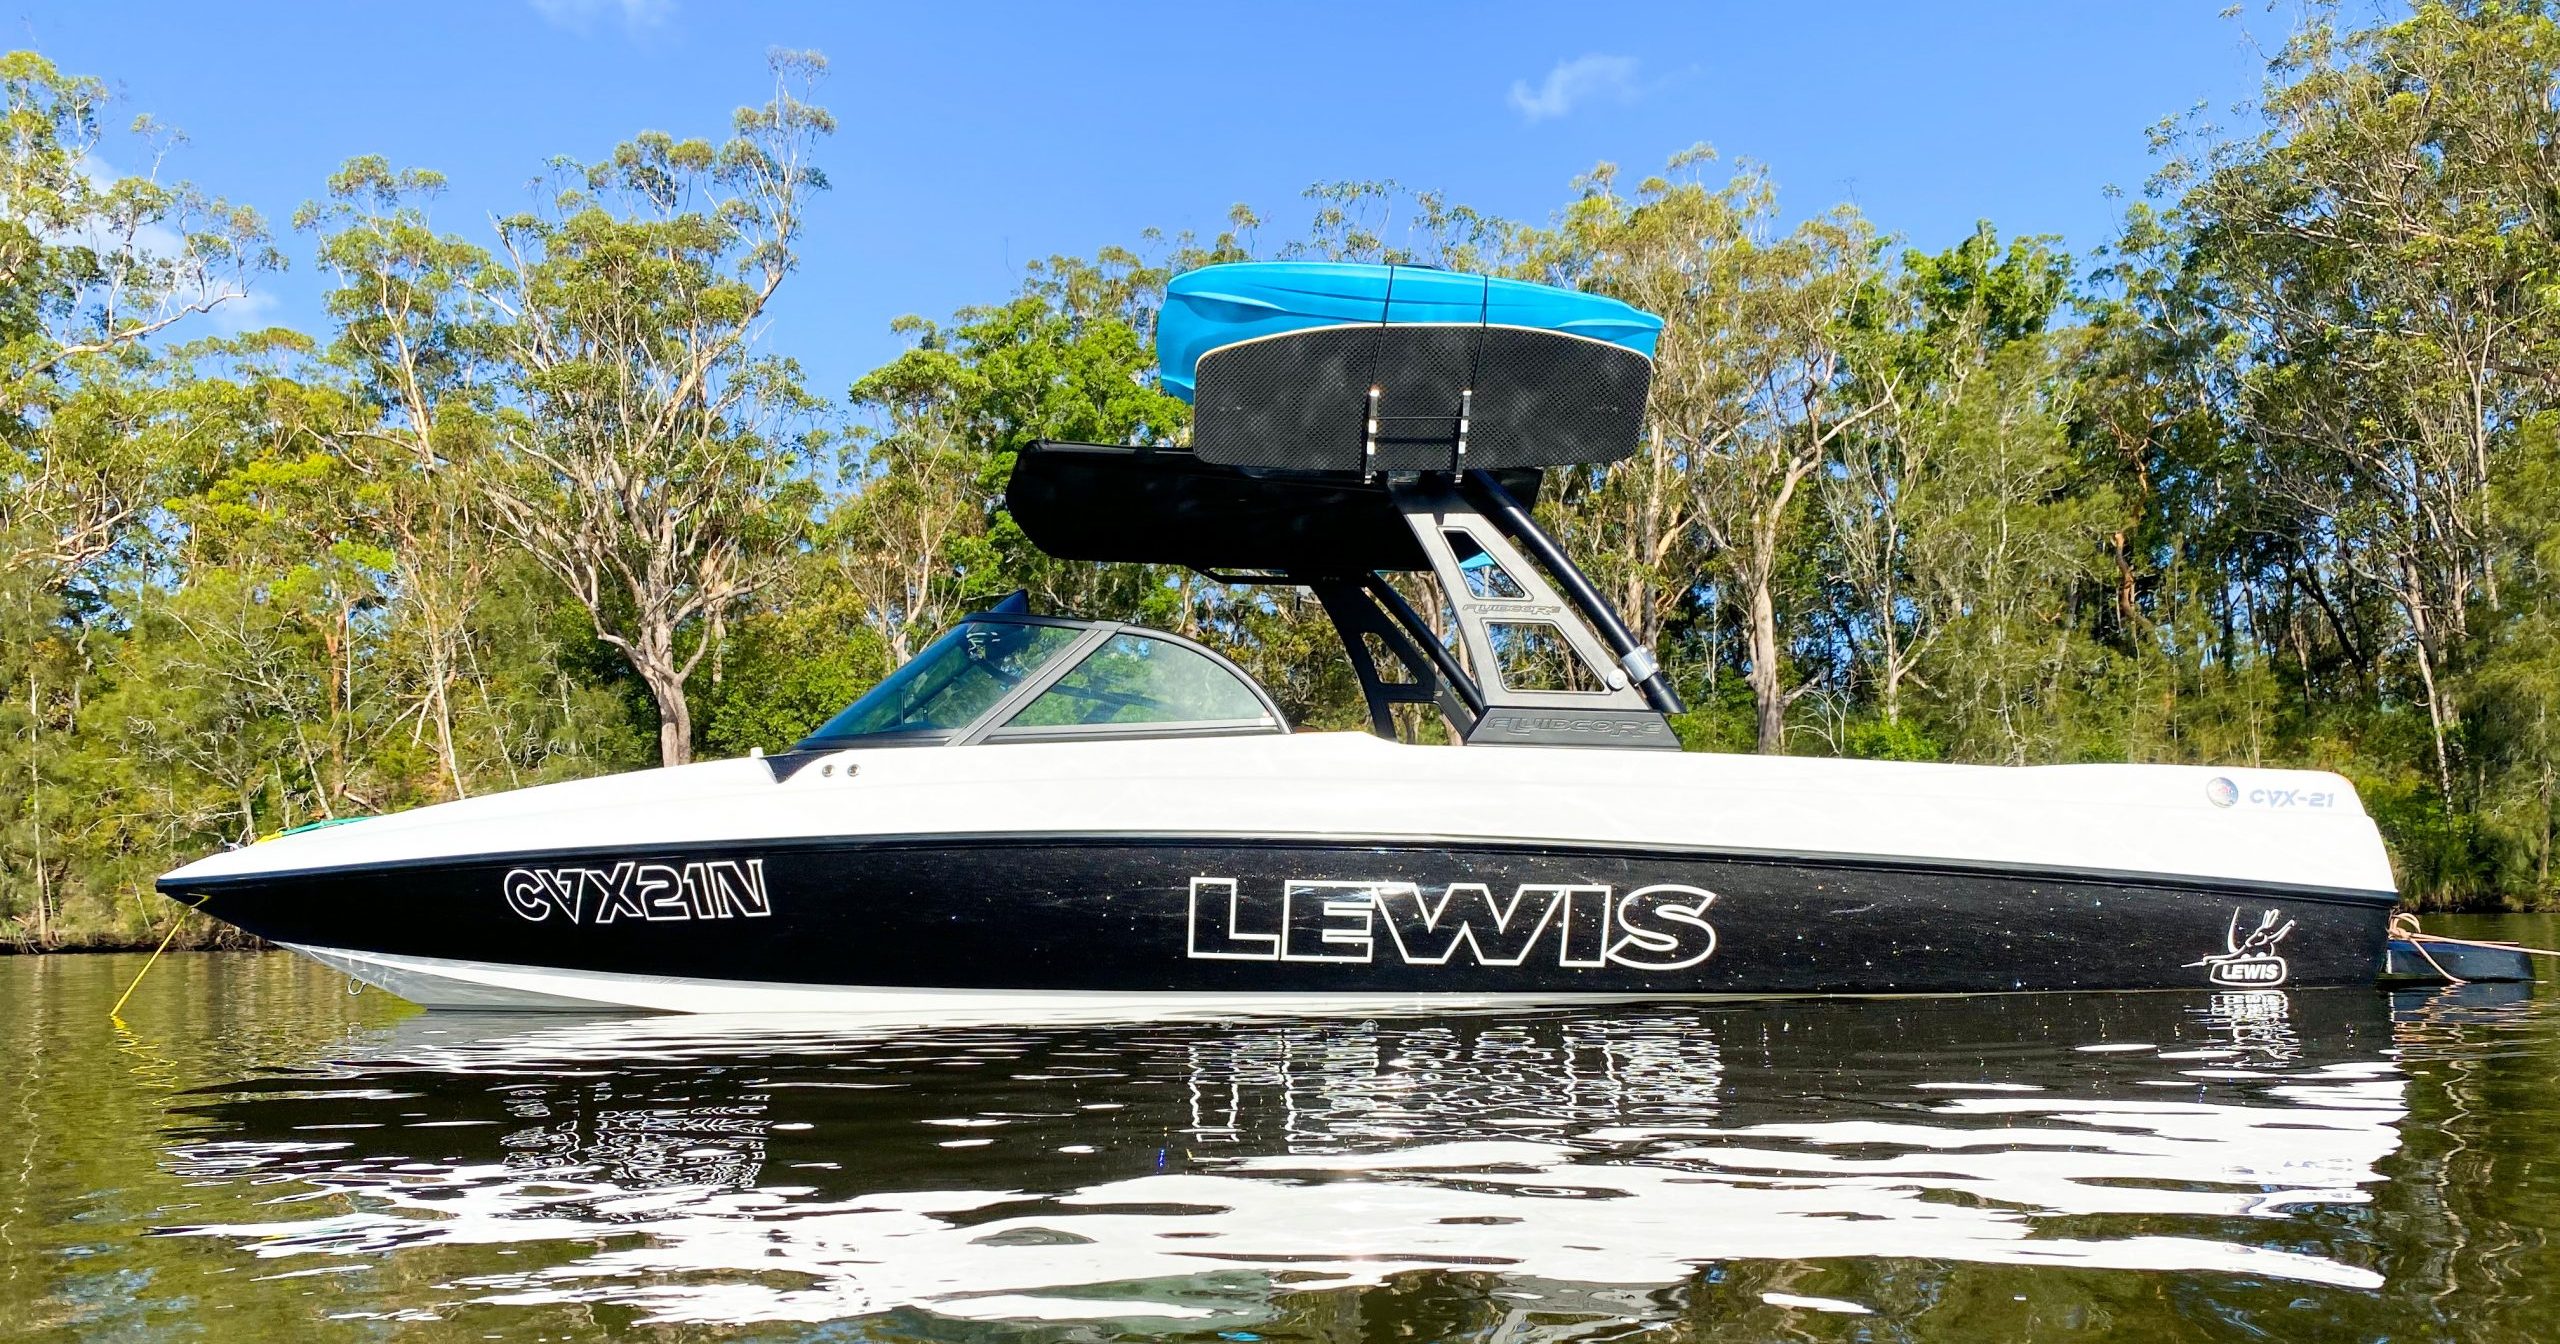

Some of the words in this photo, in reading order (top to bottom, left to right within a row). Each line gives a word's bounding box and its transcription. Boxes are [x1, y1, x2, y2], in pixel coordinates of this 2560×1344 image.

[1487, 716, 1662, 737] FLUIDCORE
[2249, 788, 2334, 808] CVX-21
[504, 859, 771, 924] CVX21N
[1187, 877, 1717, 970] LEWIS
[2221, 963, 2279, 980] LEWIS
